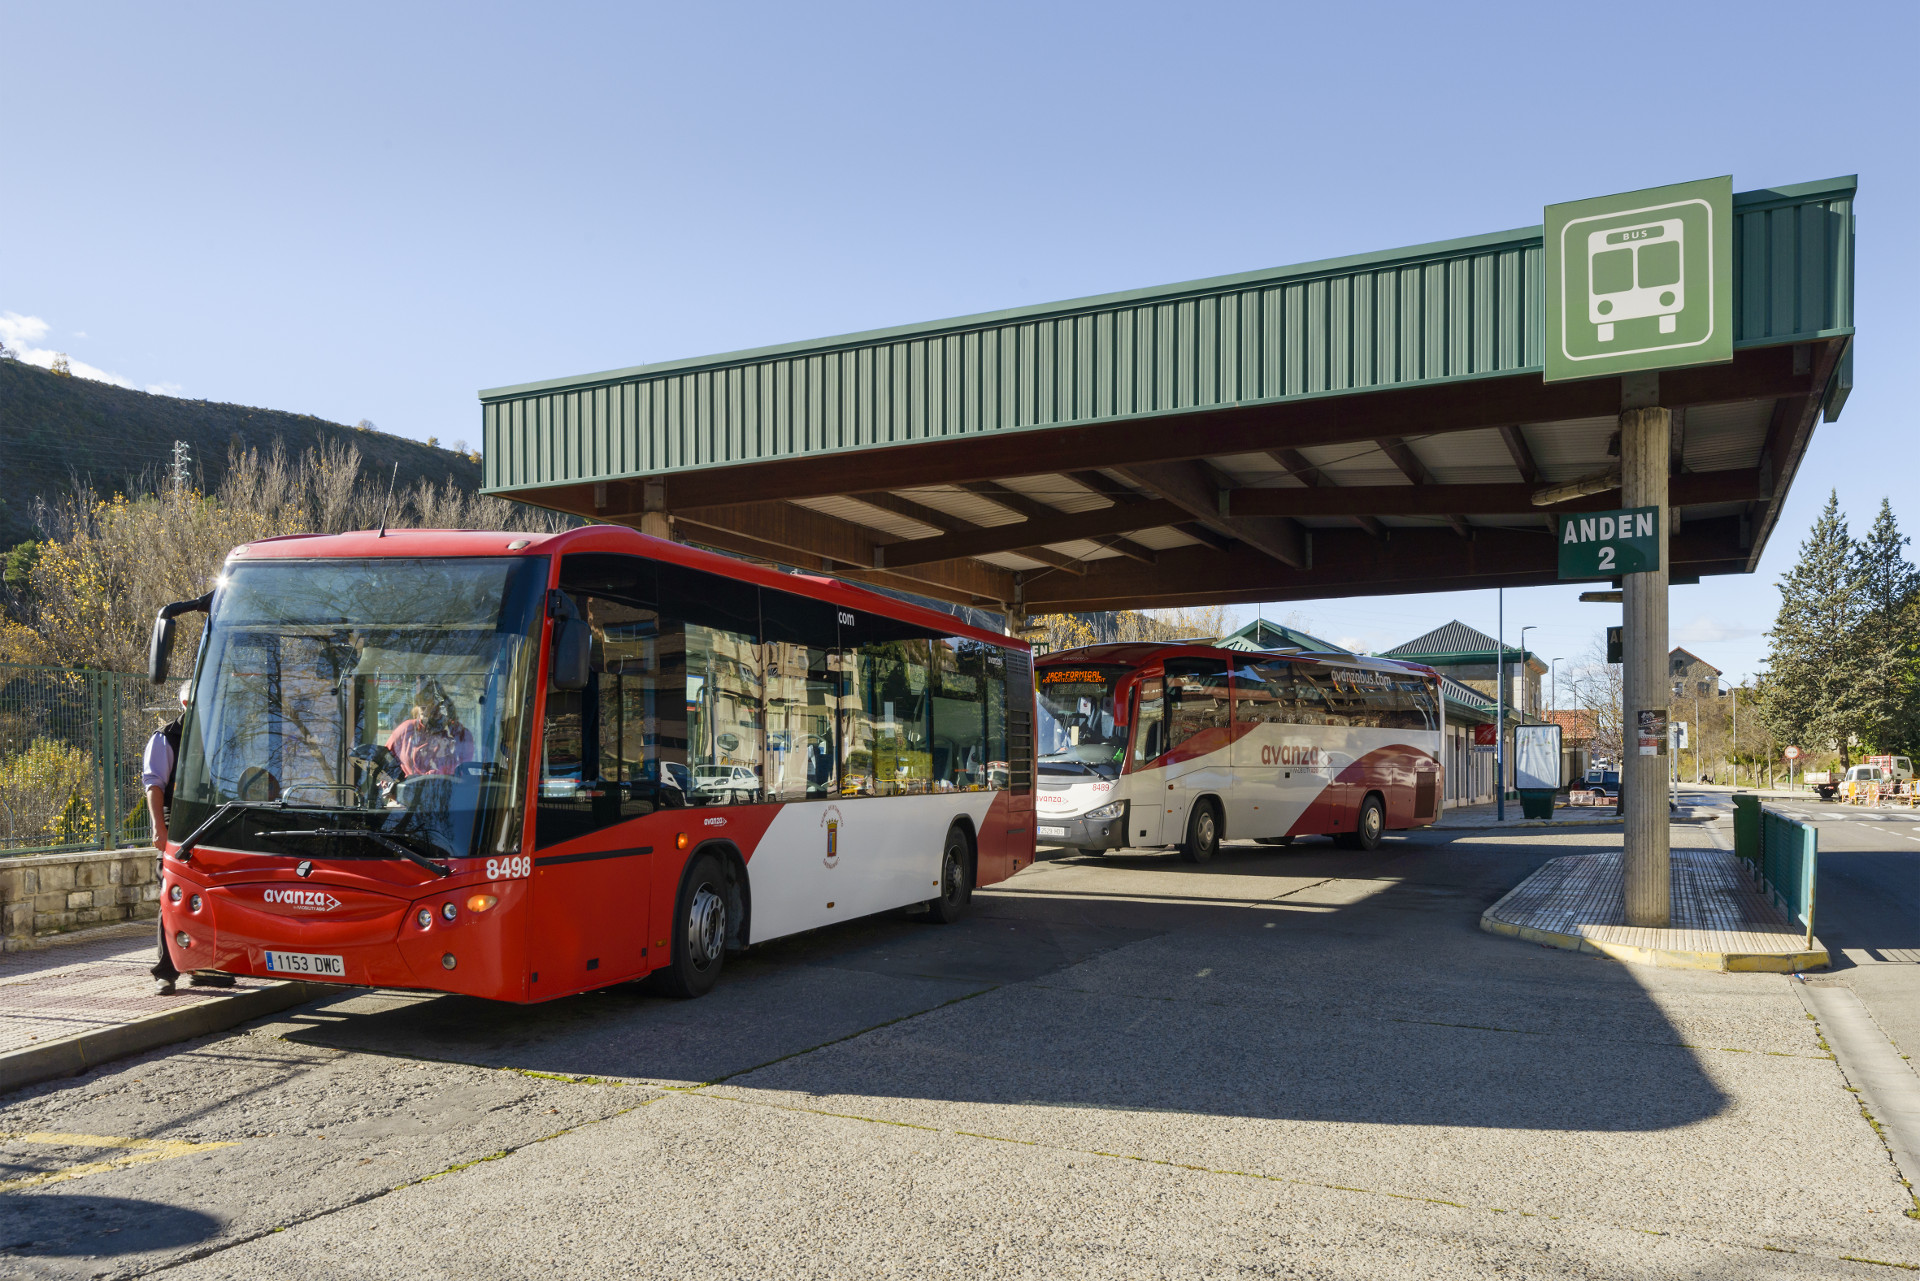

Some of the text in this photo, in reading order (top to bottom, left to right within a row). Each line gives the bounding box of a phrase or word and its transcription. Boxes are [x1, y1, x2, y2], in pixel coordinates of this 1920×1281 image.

[1623, 230, 1647, 240] BUS
[1564, 513, 1652, 544] ANDEN
[1598, 546, 1615, 570] 2
[1046, 670, 1102, 679] JACA-FORMIGAL
[1331, 668, 1392, 687] avanzabus.com
[1261, 744, 1319, 765] avanza
[486, 856, 531, 880] 8498
[264, 888, 325, 906] avanza
[277, 954, 309, 971] 1153
[315, 957, 341, 973] DWC
